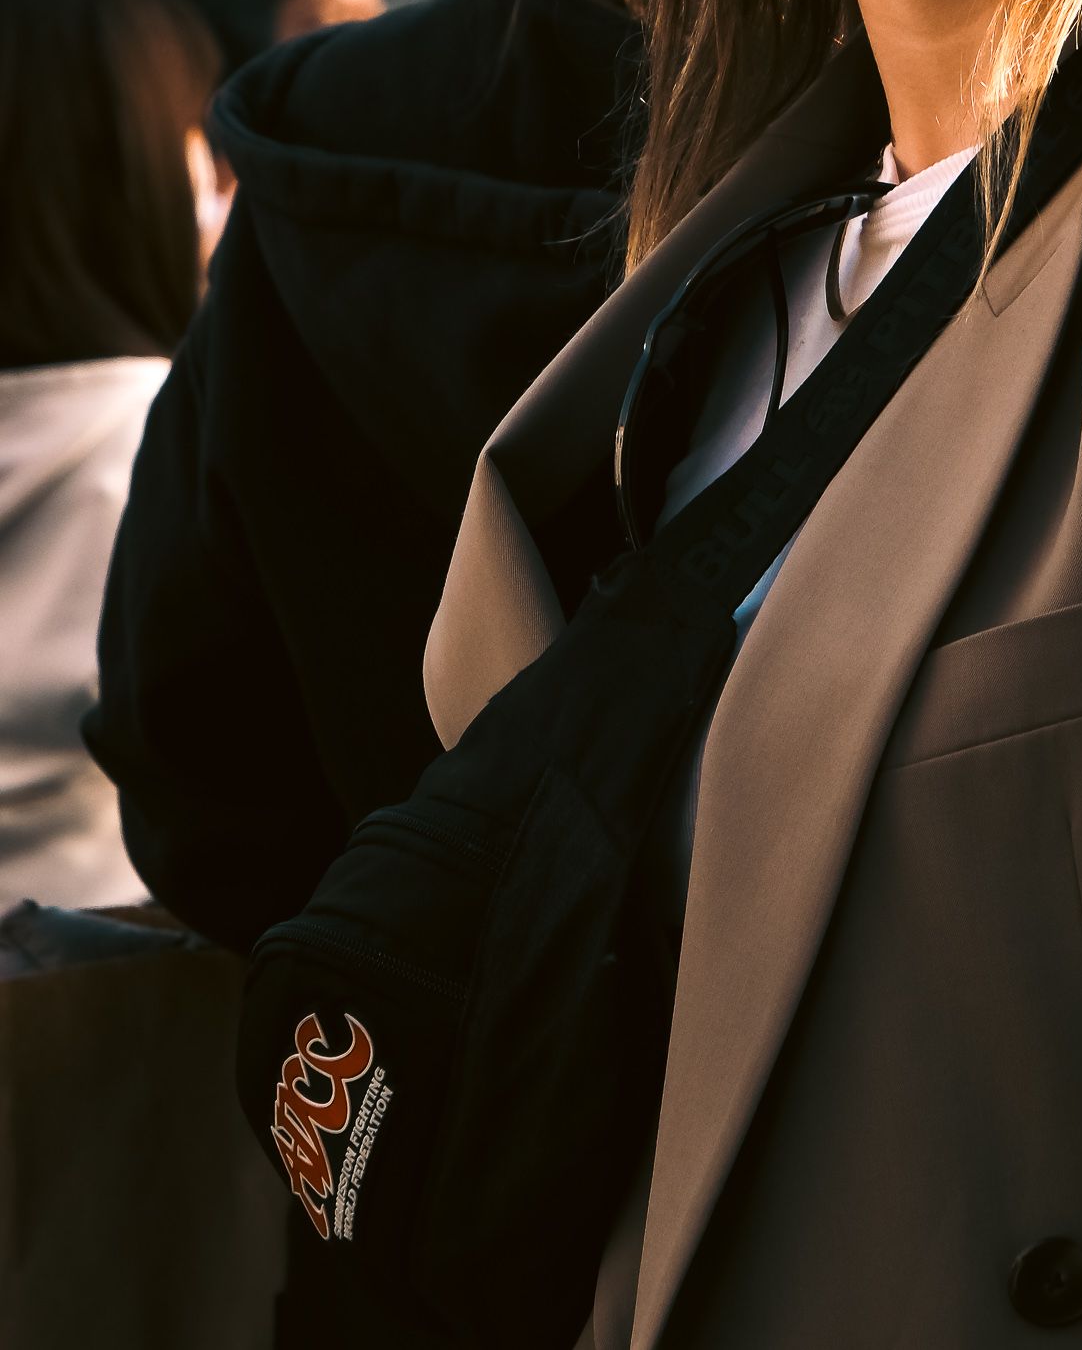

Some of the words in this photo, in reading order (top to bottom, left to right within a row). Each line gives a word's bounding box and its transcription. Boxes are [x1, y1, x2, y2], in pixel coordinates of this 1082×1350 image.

[333, 1146, 355, 1240] SUBMISSION
[349, 1065, 386, 1147] FIGHTING
[350, 1084, 394, 1190] FEDERATION
[343, 1187, 358, 1241] WORLD
